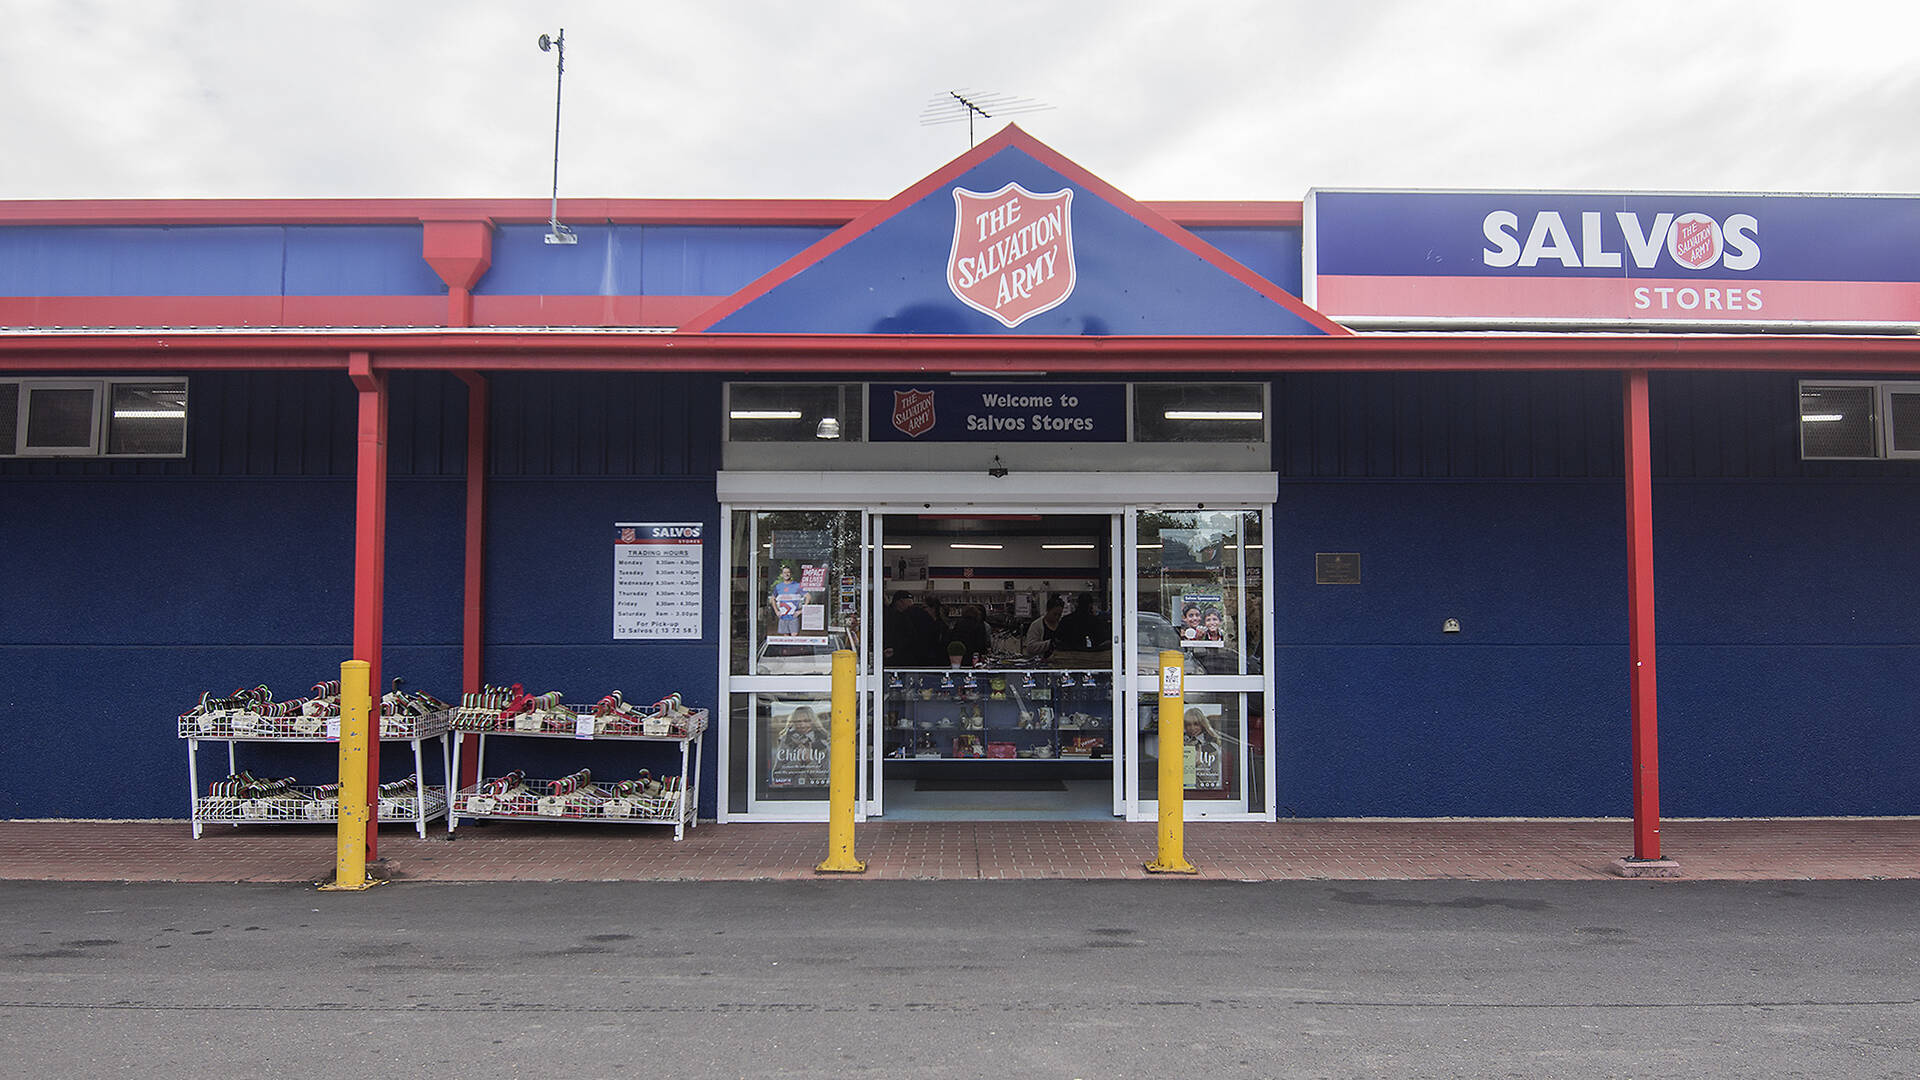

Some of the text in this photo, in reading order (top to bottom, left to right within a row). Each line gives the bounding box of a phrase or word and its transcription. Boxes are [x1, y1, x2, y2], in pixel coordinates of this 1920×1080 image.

[976, 197, 1021, 242] THE
[1682, 222, 1697, 238] THE
[958, 205, 1062, 288] SALVATION
[1483, 210, 1761, 271] SALVOS
[1678, 224, 1711, 256] SALVATION
[1691, 239, 1710, 262] ARMY
[995, 244, 1058, 309] ARMY
[1634, 286, 1763, 310] STORES
[895, 395, 931, 425] SALVATION
[901, 393, 918, 408] THE
[982, 393, 1079, 407] Welcome to
[908, 409, 930, 431] ARMY
[967, 414, 1094, 430] Salvos Stores
[652, 527, 700, 537] SALVOS
[777, 748, 826, 764] Chill Up
[1200, 751, 1216, 766] Up
